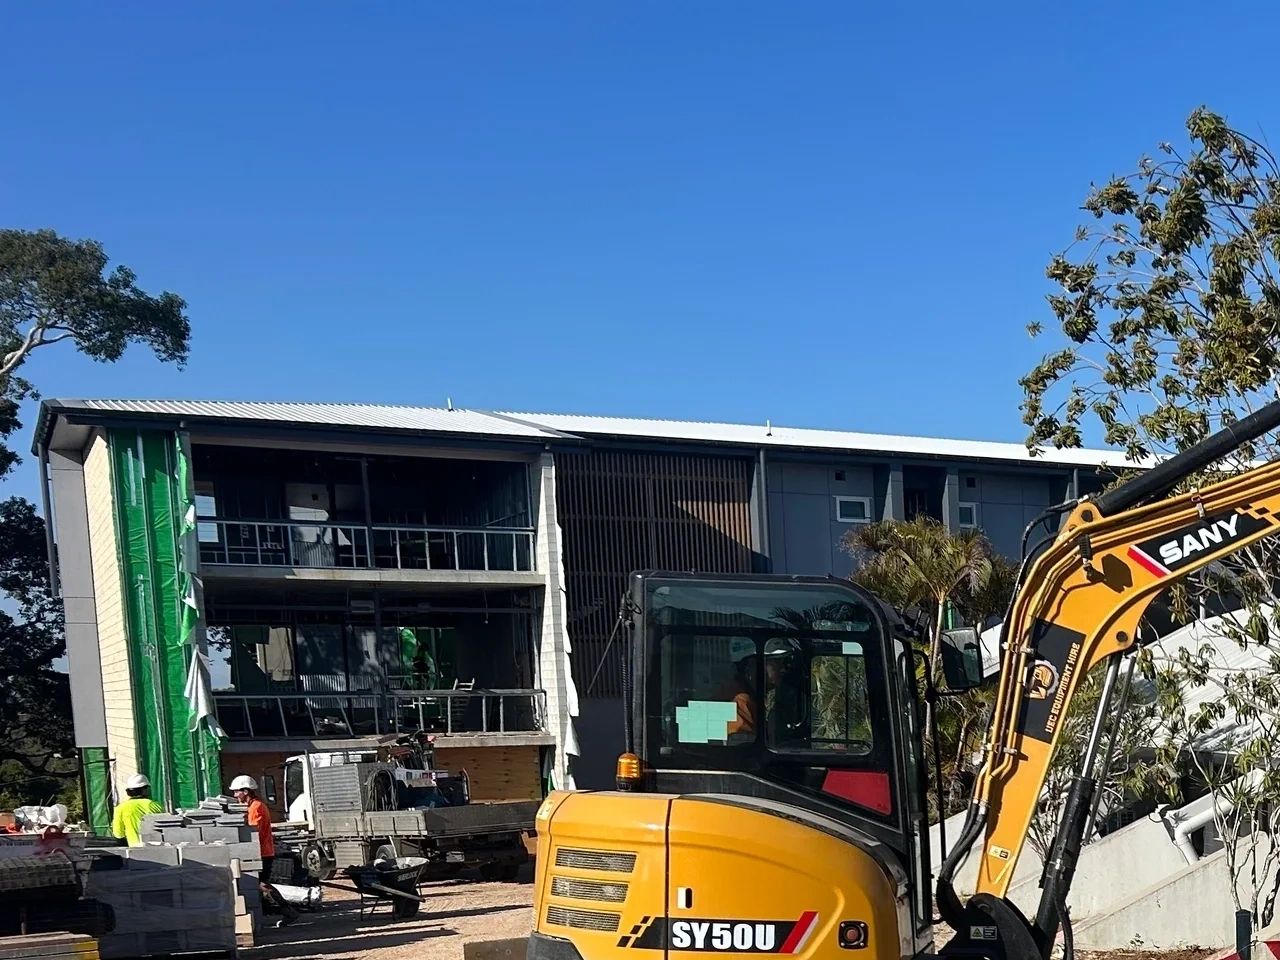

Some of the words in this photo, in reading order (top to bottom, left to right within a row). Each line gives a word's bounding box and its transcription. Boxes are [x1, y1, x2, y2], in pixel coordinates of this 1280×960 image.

[1160, 515, 1239, 565] SANY
[1044, 713, 1058, 734] UEC
[1051, 666, 1074, 715] EQUIPMENT
[1067, 642, 1080, 667] HIRE
[672, 921, 775, 951] SY50U
